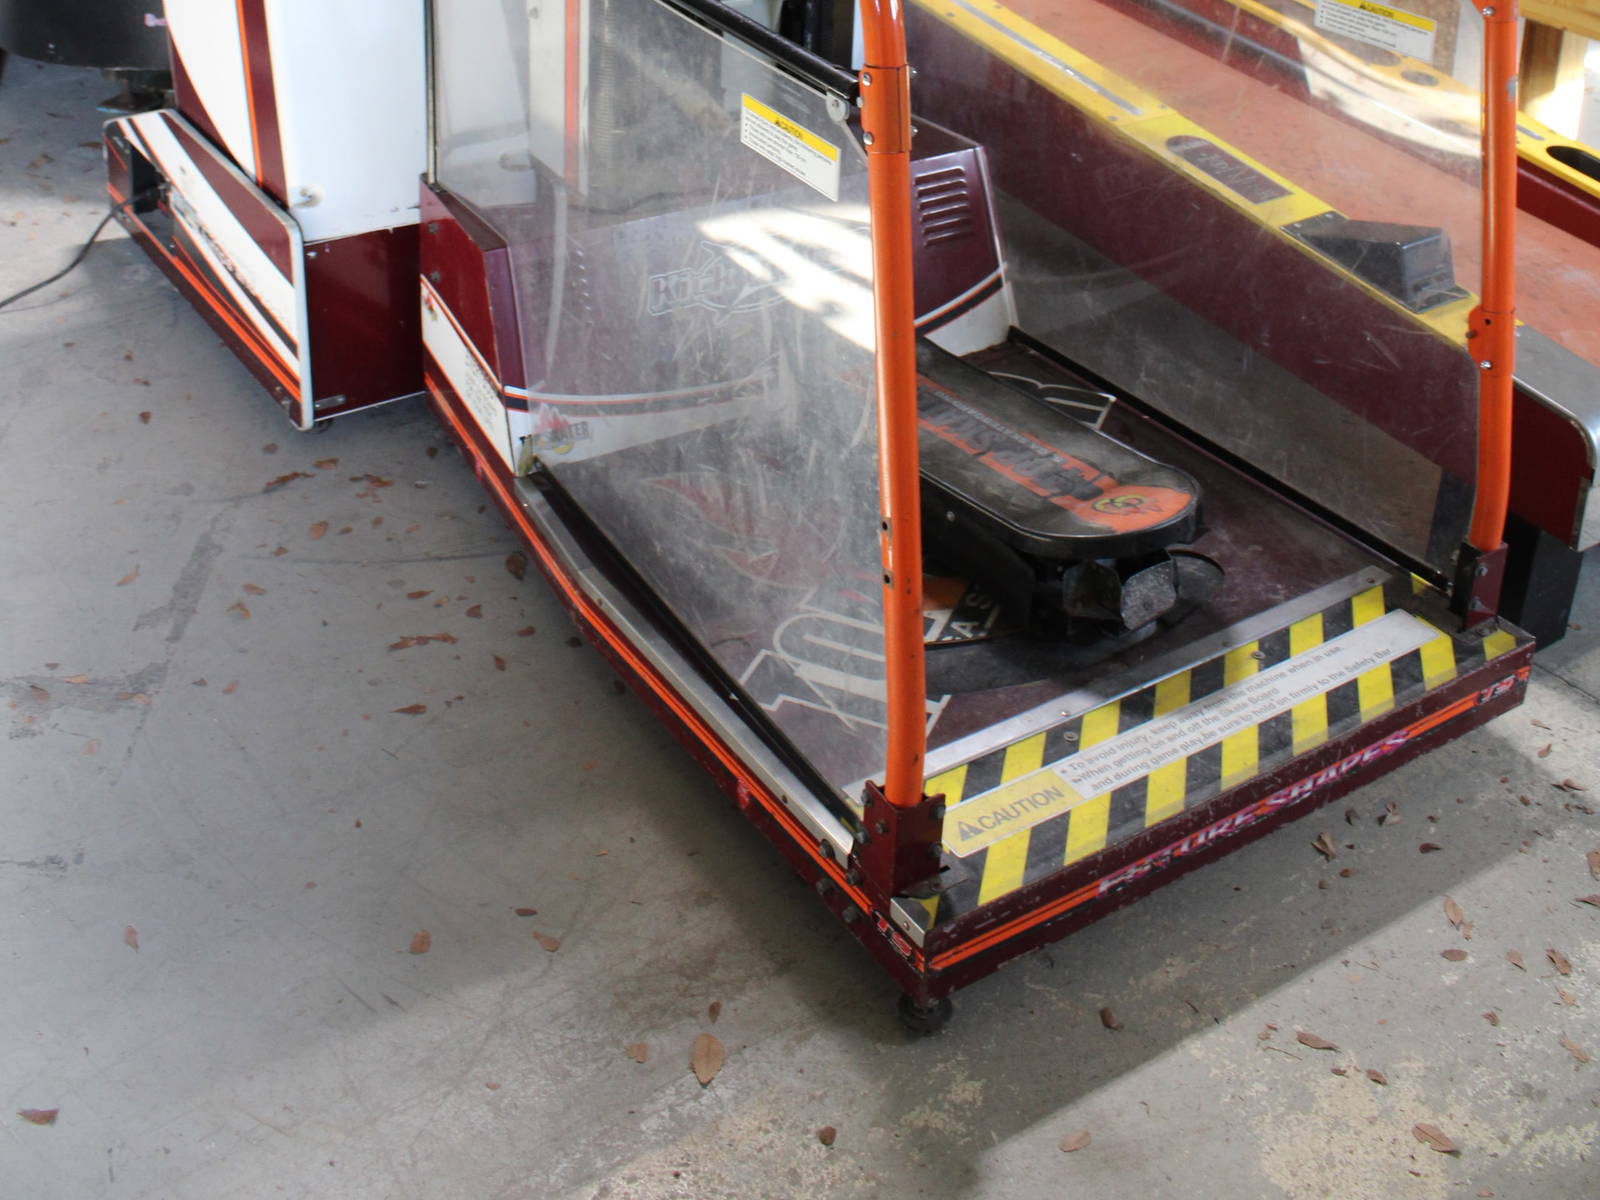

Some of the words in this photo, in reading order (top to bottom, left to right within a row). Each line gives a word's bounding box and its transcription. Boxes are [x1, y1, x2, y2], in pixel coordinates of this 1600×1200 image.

[1079, 763, 1112, 781] When
[1113, 745, 1152, 769] getting
[1247, 686, 1281, 704] Board
[1087, 747, 1115, 765] avoid
[1151, 720, 1179, 737] keep
[1246, 671, 1287, 693] machine
[1288, 657, 1314, 675] when
[1314, 652, 1325, 663] in
[1114, 759, 1150, 783] during
[1150, 748, 1180, 769] game
[1219, 717, 1242, 734] sure
[1252, 701, 1278, 719] hold
[1288, 681, 1320, 701] firmly
[1343, 655, 1377, 676] Safety
[976, 785, 1065, 830] CAUTION
[1262, 730, 1409, 808] SHAPES
